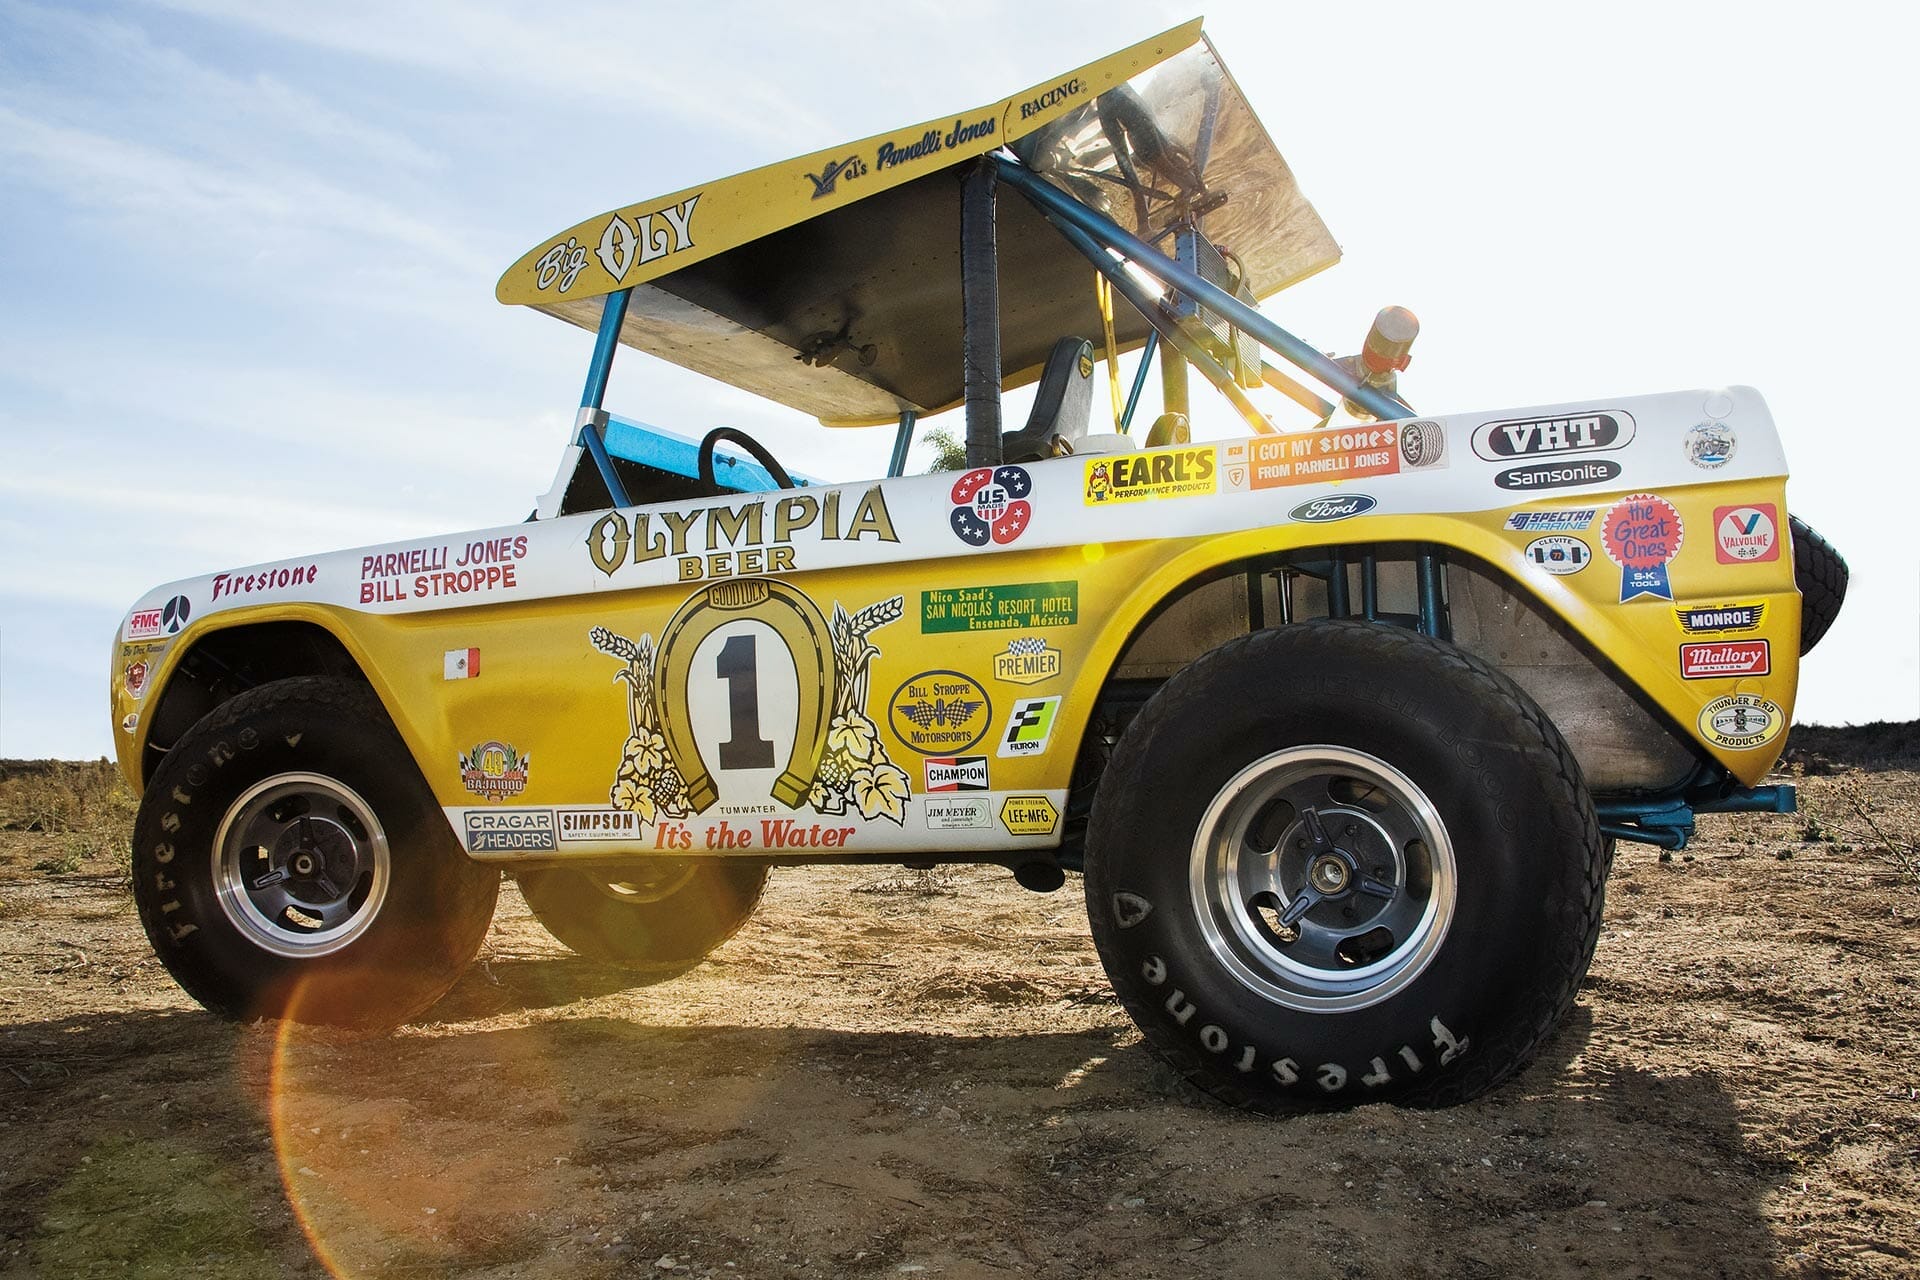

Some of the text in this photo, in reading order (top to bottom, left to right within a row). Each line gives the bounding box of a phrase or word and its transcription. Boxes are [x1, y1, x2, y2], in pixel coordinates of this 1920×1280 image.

[876, 131, 942, 171] Parnelli
[945, 117, 995, 150] Jones
[1020, 78, 1080, 120] RACING
[535, 192, 703, 293] Big OLY
[1502, 414, 1602, 453] VHT
[1250, 443, 1256, 461] I
[1259, 440, 1289, 461] GOT
[1292, 438, 1313, 457] MY
[1112, 449, 1214, 487] EARL'S
[1258, 464, 1290, 480] FROM
[1295, 457, 1350, 475] PARNELLI
[1353, 452, 1389, 468] JONES
[1508, 464, 1608, 486] Samsonite
[977, 488, 1007, 505] U.S.
[1114, 481, 1211, 499] PERFORMANCE PRODUCTS
[1305, 498, 1359, 519] Ford
[1530, 510, 1596, 522] SPECTRA
[1629, 503, 1653, 520] the
[585, 483, 901, 578] OLYMPIA
[1525, 521, 1589, 530] MARINE
[1614, 518, 1670, 540] Great
[1539, 538, 1574, 546] CLEVITE
[1623, 539, 1667, 560] Ones
[1723, 532, 1768, 549] VALVOLINE
[361, 535, 528, 580] PARNELLI JONES
[678, 545, 798, 581] BEER
[212, 564, 318, 601] Firestone
[359, 564, 517, 604] BILL STROPPE
[1630, 579, 1660, 588] TOOLS
[712, 581, 766, 606] GOOD LUCK
[930, 588, 994, 603] Nico Saad's
[927, 597, 1073, 619] SAN NICOLAS RESORT HOTEL
[131, 613, 159, 629] FMC
[969, 614, 1069, 630] Ensenada, México
[1691, 611, 1751, 628] MONROE
[999, 655, 1056, 676] PREMIER
[1690, 647, 1762, 667] Mallory
[908, 683, 970, 698] BILL STROPPE
[716, 634, 776, 770] 1
[1707, 696, 1775, 714] THUNDER BRD
[911, 731, 972, 744] MOTORSPORTS
[1010, 741, 1039, 751] FILTRON
[1715, 732, 1766, 746] PRODUCTS
[929, 767, 985, 781] CHAMPION
[720, 805, 776, 815] TUMWATER
[928, 808, 943, 818] JIM
[469, 815, 550, 830] CRAGAR
[563, 813, 633, 830] SIMPSON
[487, 832, 552, 849] HEADERS
[654, 819, 856, 850] It's the Water
[1141, 953, 1470, 1092] Firestone
